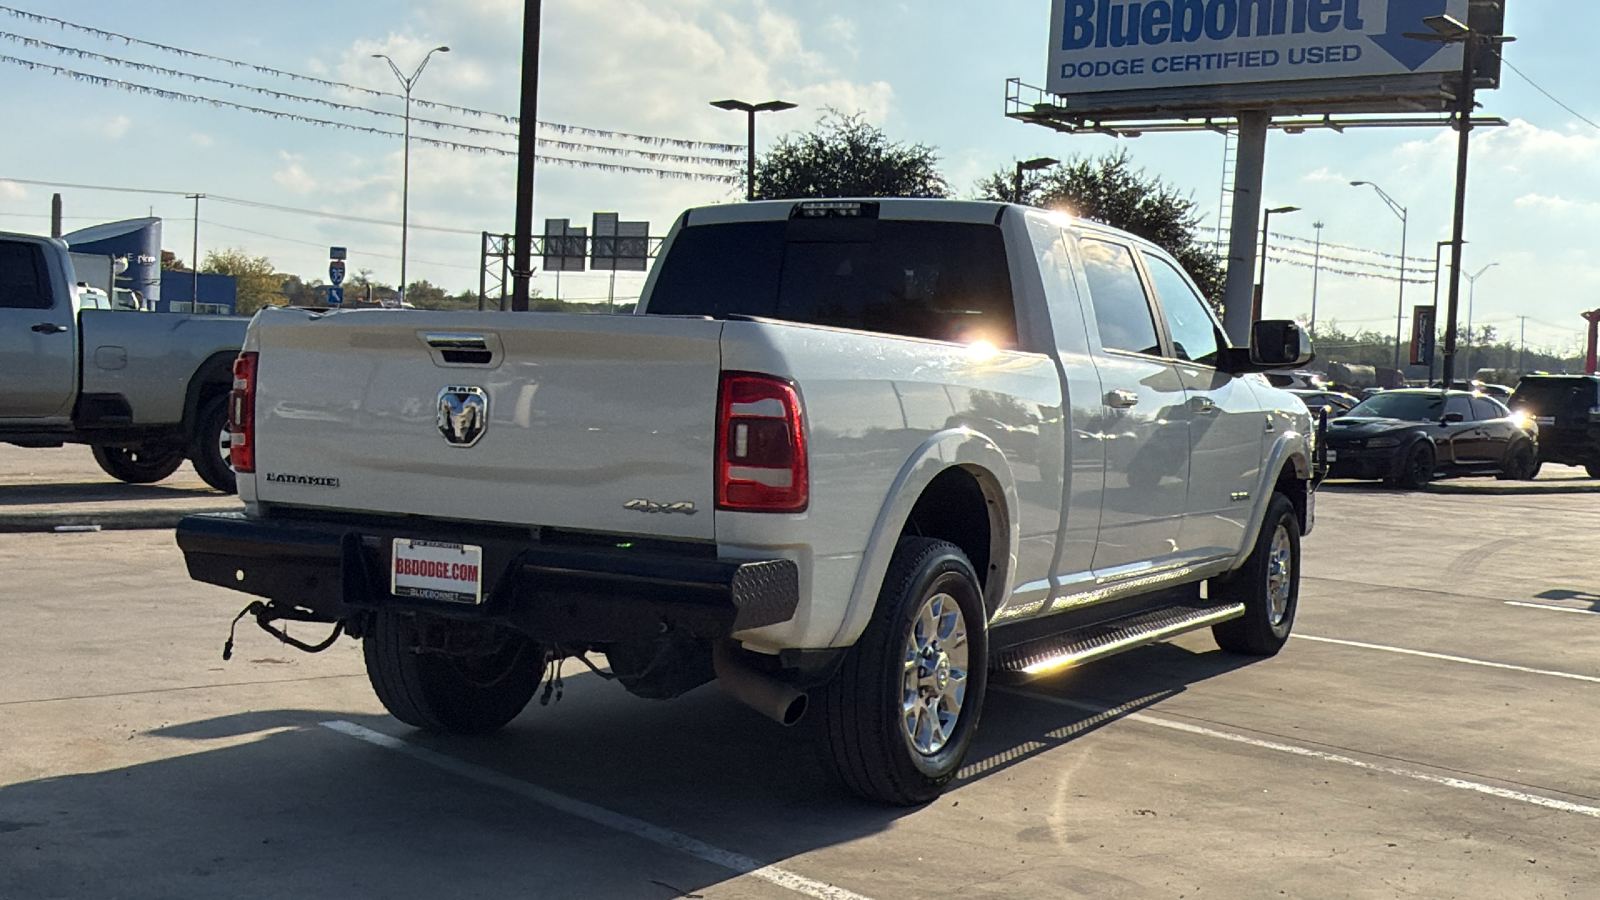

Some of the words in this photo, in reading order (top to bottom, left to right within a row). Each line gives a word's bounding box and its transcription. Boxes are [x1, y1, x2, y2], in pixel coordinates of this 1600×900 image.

[1062, 0, 1363, 50] Bluebonnet
[1061, 59, 1144, 79] DODGE
[1151, 50, 1280, 73] CERTIFIED
[1288, 45, 1362, 65] USED
[266, 472, 340, 487] LARAMIE
[396, 558, 478, 582] BBDODGE.COM
[410, 588, 459, 600] BLUEBONNET
